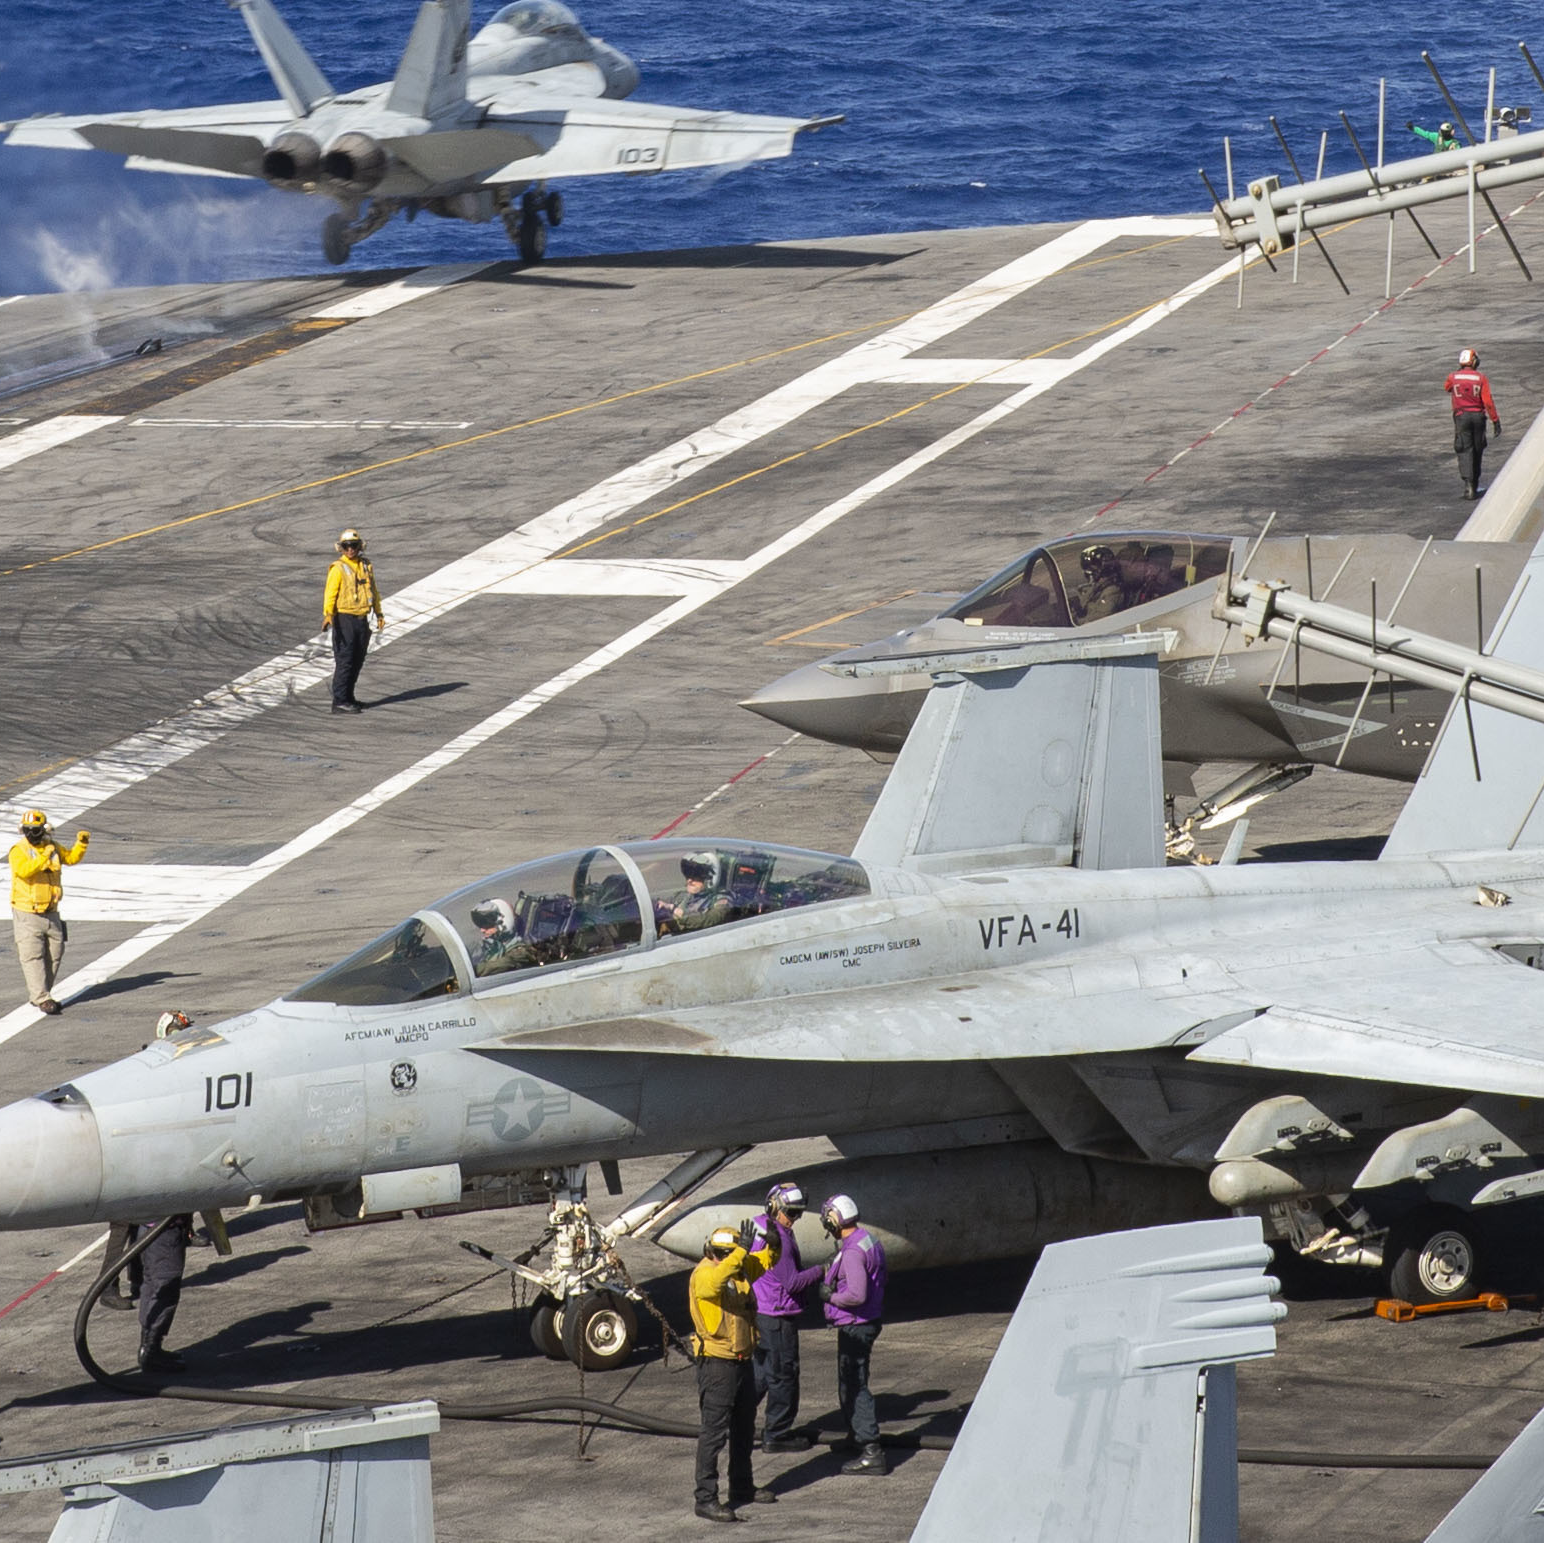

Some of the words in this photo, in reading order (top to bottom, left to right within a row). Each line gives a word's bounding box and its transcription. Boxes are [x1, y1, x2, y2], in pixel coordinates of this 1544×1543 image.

[616, 148, 660, 165] 103
[978, 908, 1080, 950] VFA-41
[779, 953, 812, 965] CMDCM
[852, 943, 885, 955] JOSEPH
[887, 938, 921, 951] SILVEIRA
[842, 957, 862, 968] CMC
[344, 1027, 395, 1042] AFCM(AW)
[399, 1023, 426, 1035] JUAN
[428, 1017, 477, 1032] CARRILLO
[394, 1031, 429, 1044] MMCPO
[205, 1071, 253, 1113] 101
